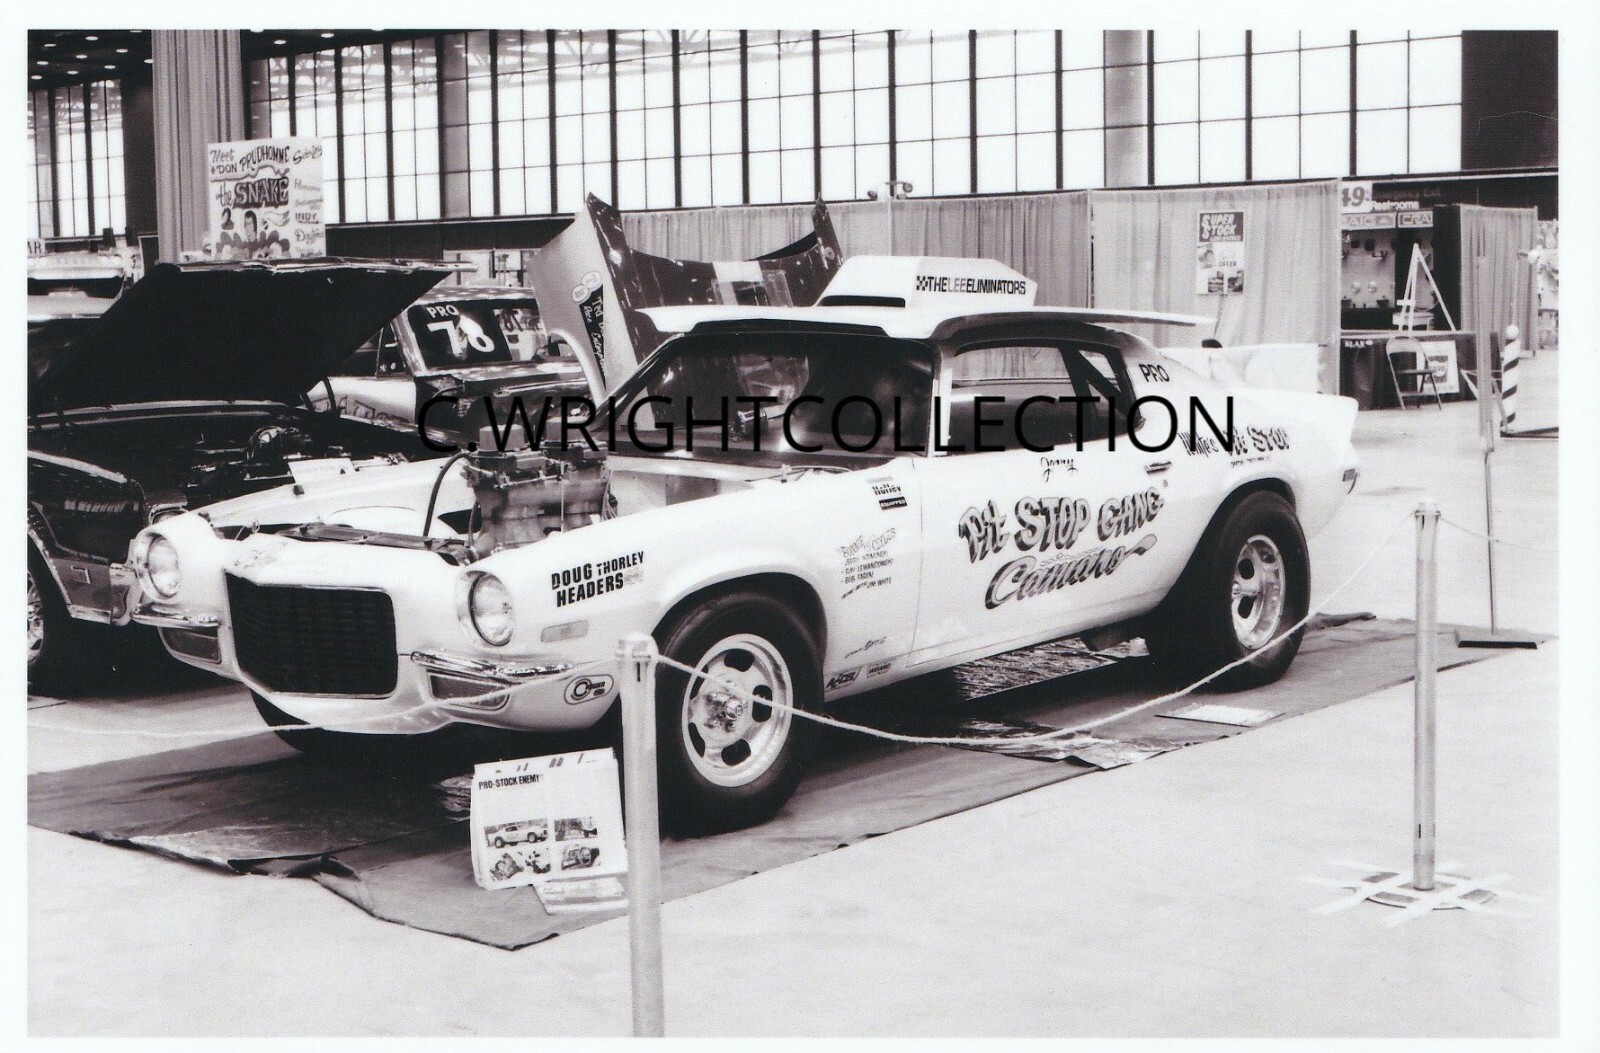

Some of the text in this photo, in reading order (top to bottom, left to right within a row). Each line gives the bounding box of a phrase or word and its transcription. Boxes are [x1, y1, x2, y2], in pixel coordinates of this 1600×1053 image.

[233, 177, 289, 208] SNAKE
[1202, 214, 1235, 229] SUPER
[1202, 225, 1237, 239] STOCK
[426, 304, 460, 318] PRO
[427, 314, 495, 357] 78
[1139, 364, 1170, 382] PRO
[958, 486, 1165, 563] Pit STOP GANG
[551, 563, 592, 590] DOUG
[596, 551, 644, 576] THORLEY
[985, 534, 1157, 610] Camaro
[556, 572, 624, 608] HEADERS
[478, 773, 541, 790] PRO-STOCK ENEMY
